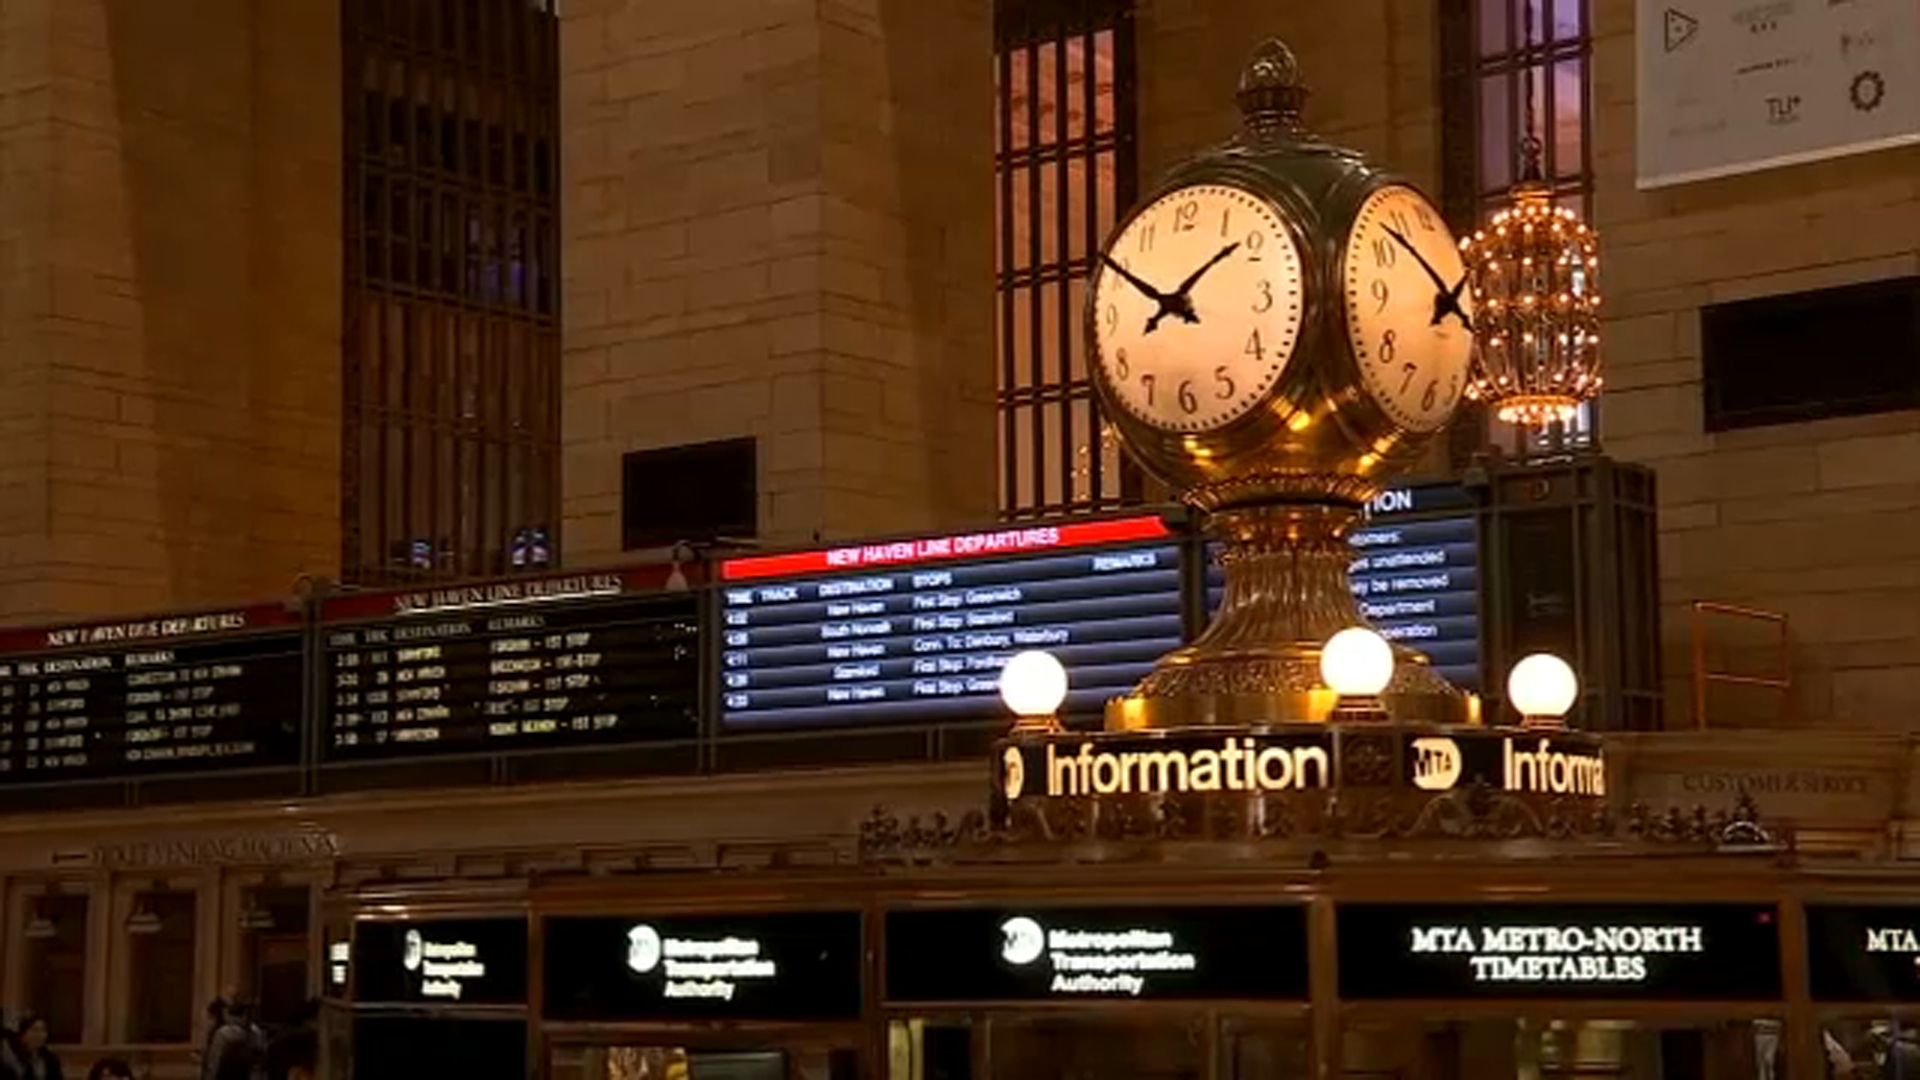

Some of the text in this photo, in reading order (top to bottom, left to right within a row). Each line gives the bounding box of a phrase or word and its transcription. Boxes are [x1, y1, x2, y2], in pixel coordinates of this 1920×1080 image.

[1173, 201, 1198, 233] 12
[1219, 207, 1231, 237] 1
[1139, 223, 1156, 252] 11
[1373, 237, 1396, 268] 10
[1251, 280, 1274, 313] 3
[1371, 278, 1389, 315] 9
[1106, 303, 1119, 336] 9
[1244, 328, 1267, 361] 4
[1379, 329, 1396, 364] 8
[1116, 347, 1129, 381] 8
[1400, 362, 1418, 395] 7
[1140, 373, 1156, 406] 7
[1178, 380, 1198, 414] 6
[1214, 366, 1235, 400] 5
[1421, 380, 1438, 412] 6
[827, 527, 1060, 565] NEW HAVEN LINE DEPARTURES
[1373, 550, 1445, 567] unattended
[761, 587, 797, 601] TRACK
[819, 578, 893, 597] DESTINATION
[913, 571, 951, 588] STOPS
[1093, 553, 1156, 571] REMARKS
[1371, 578, 1388, 592] be
[1392, 573, 1448, 590] removed
[1048, 737, 1329, 796] Information
[1048, 929, 1174, 952] Metropolitan
[1410, 926, 1703, 953] MTA METRO-NORTH
[1866, 926, 1919, 952] MTA
[1049, 951, 1197, 974] Transportation
[1470, 955, 1647, 981] TIMETABLES
[1051, 973, 1145, 996] Authority
